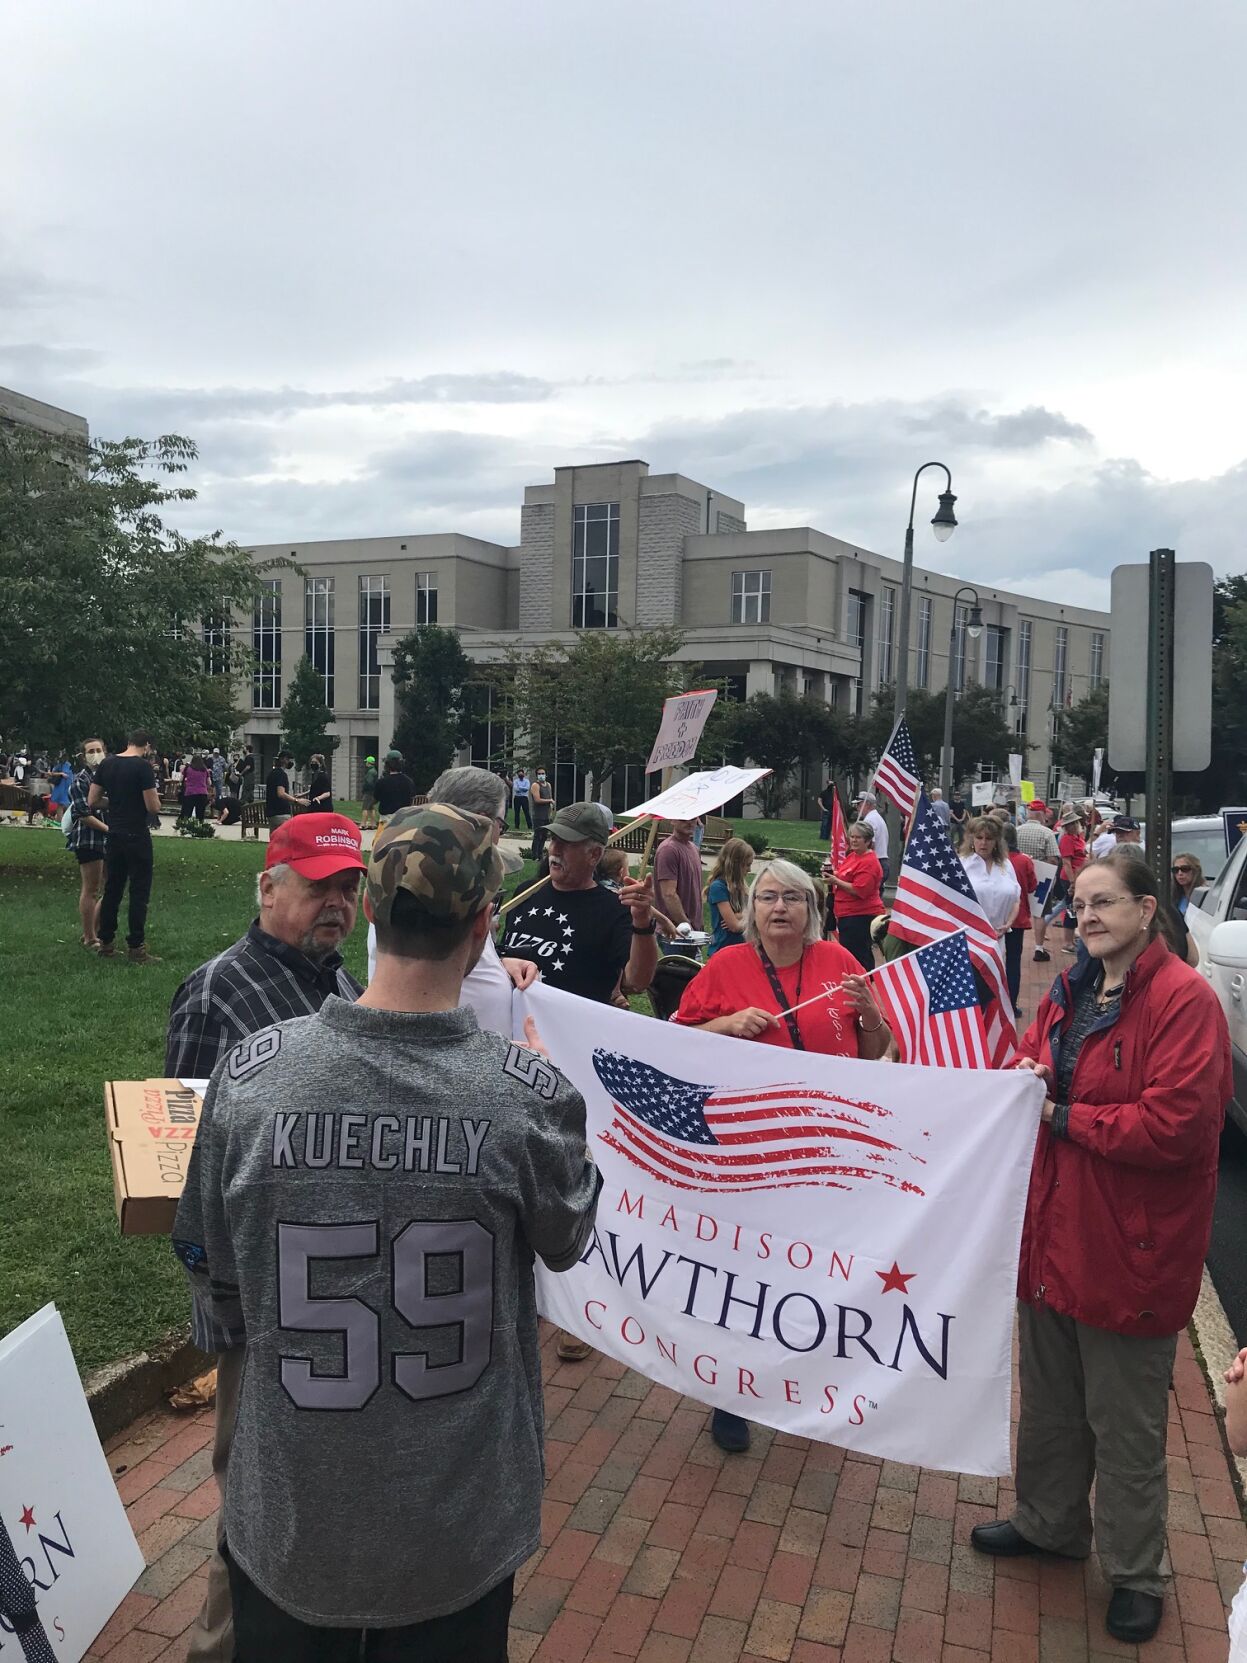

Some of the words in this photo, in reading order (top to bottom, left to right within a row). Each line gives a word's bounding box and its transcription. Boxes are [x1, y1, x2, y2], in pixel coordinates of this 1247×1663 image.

[673, 699, 705, 721] FAITH
[315, 835, 359, 849] ROBINSON
[330, 828, 350, 837] MARK
[508, 932, 558, 957] 1776
[141, 1088, 166, 1126] Pizza
[165, 1086, 197, 1124] Pizza
[155, 1141, 188, 1183] Pizza
[272, 1112, 490, 1176] KUECHLY
[616, 1188, 855, 1282] MADISON
[276, 1219, 495, 1412] 59
[584, 1300, 866, 1425] CONGRESS
